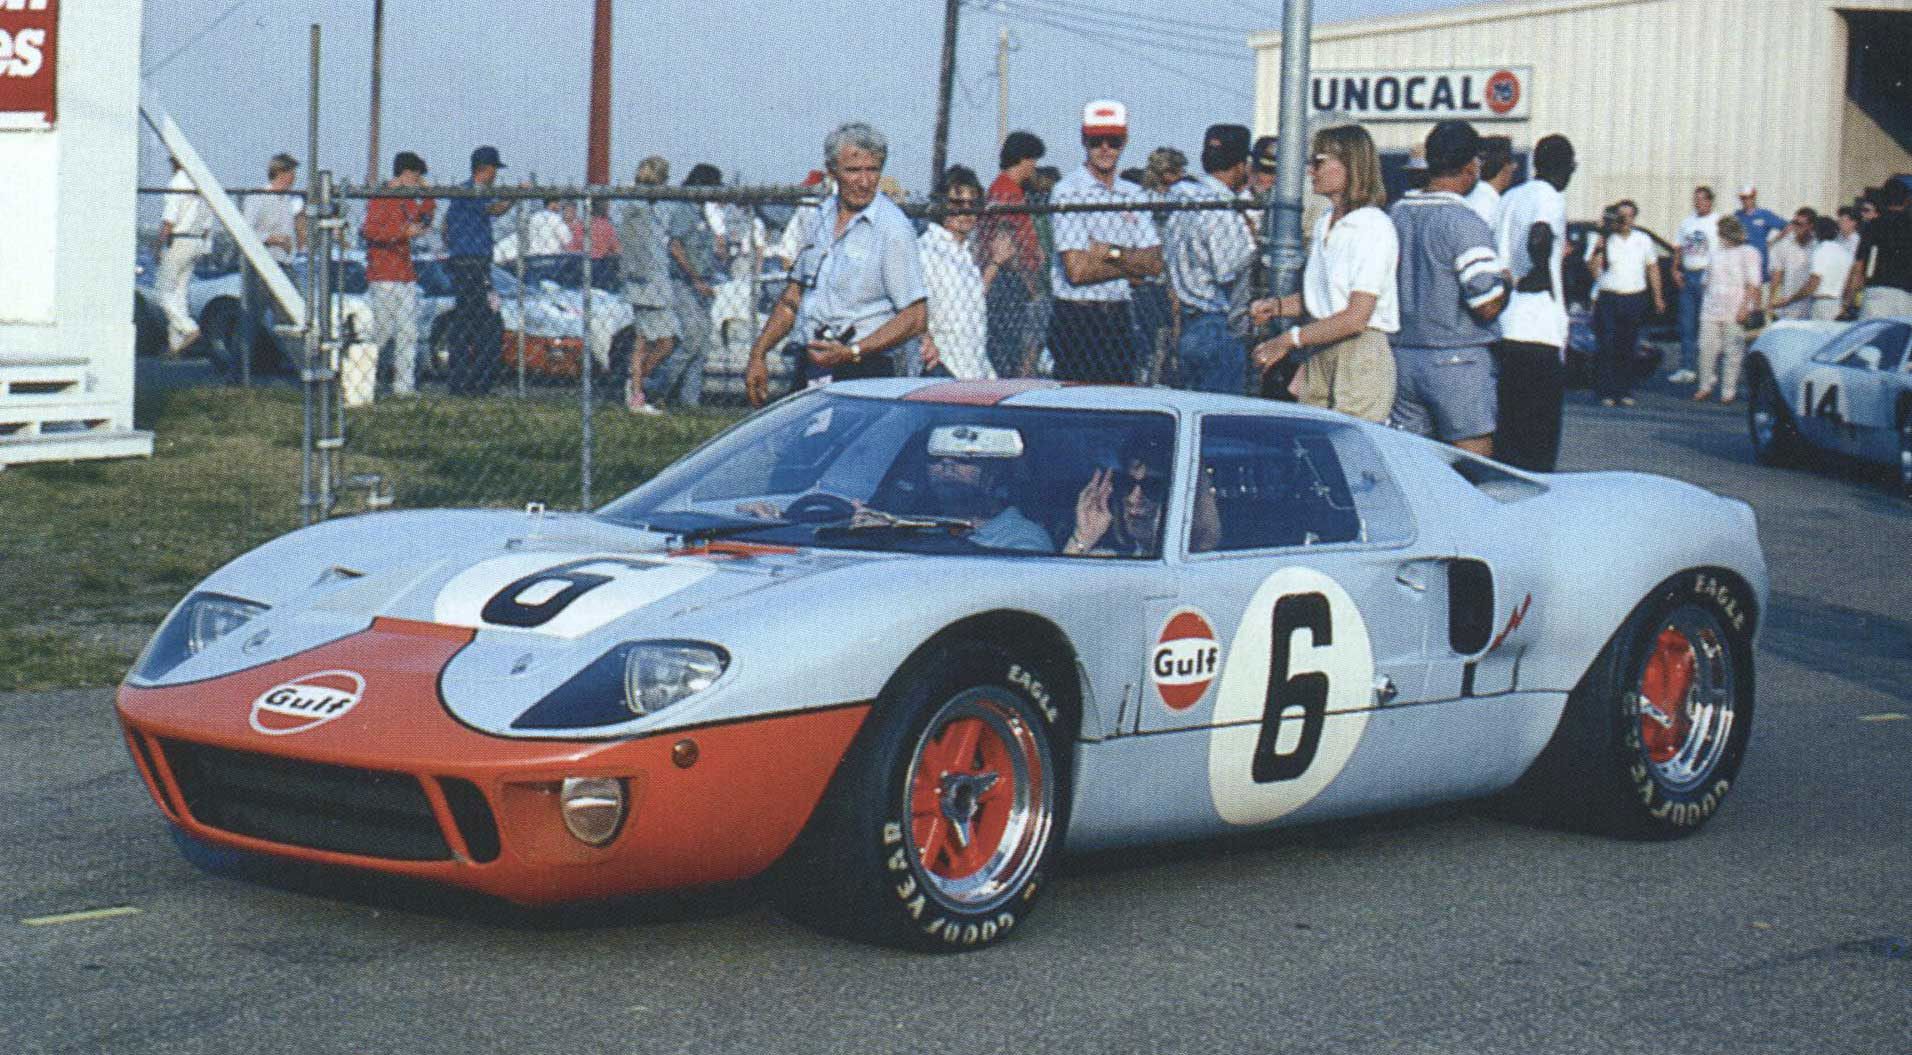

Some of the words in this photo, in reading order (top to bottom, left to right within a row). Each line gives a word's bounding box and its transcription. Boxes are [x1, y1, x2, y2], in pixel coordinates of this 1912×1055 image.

[1312, 75, 1481, 111] UNOCAL
[1804, 380, 1846, 424] 14
[480, 557, 669, 628] 6
[1694, 574, 1744, 630] EAGLE
[1154, 647, 1218, 677] Gulf
[1252, 591, 1332, 784] 6
[264, 687, 353, 716] Gulf
[1008, 664, 1057, 723] EAGLE
[883, 822, 1014, 945] GOODYEAR
